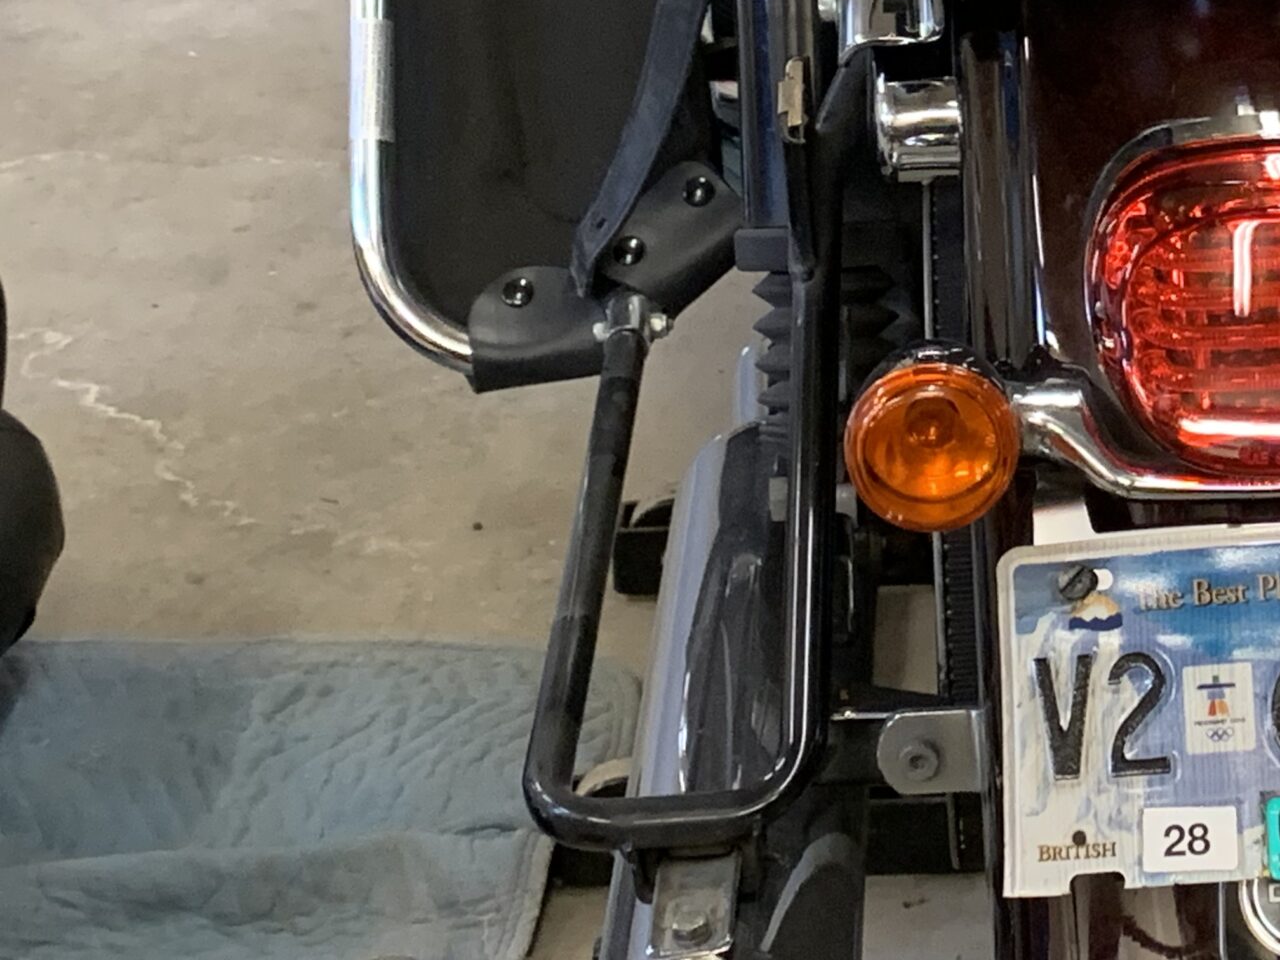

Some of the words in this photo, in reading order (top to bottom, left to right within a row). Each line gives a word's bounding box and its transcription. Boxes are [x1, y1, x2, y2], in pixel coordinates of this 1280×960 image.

[1192, 578, 1249, 606] Best
[1034, 651, 1172, 781] V2
[1038, 841, 1117, 862] BRITISH
[1163, 823, 1211, 857] 28
